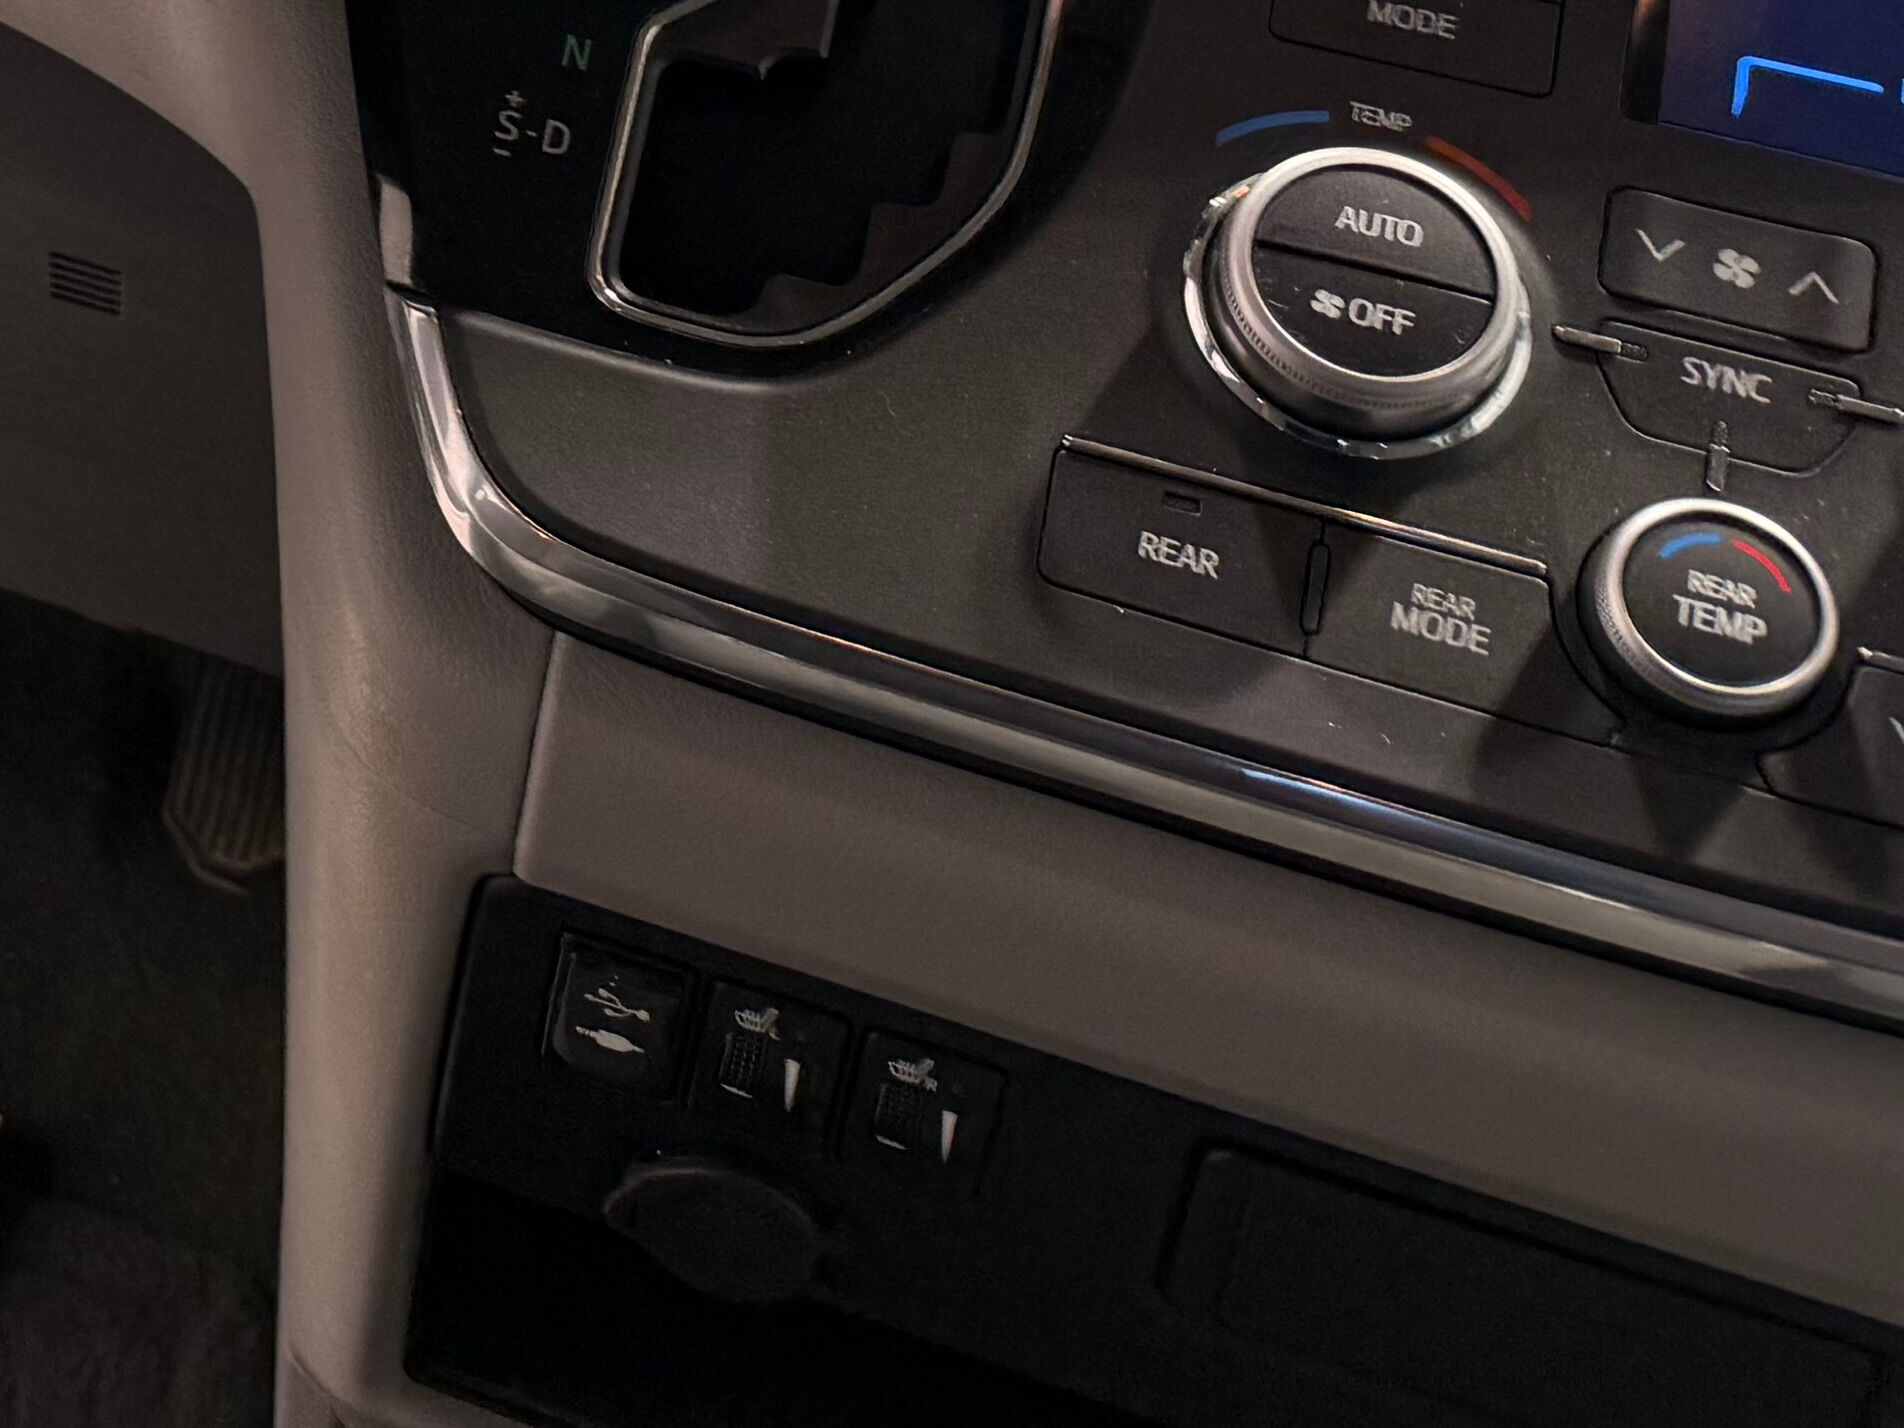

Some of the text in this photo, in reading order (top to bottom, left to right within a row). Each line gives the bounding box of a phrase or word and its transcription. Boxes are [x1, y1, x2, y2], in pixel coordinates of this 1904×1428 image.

[560, 34, 592, 71] N
[1348, 100, 1413, 132] TEMP
[1334, 204, 1425, 249] AUTO
[1347, 297, 1417, 337] OFF
[1679, 355, 1773, 405] SYNC
[1136, 530, 1220, 582] REAR
[1409, 581, 1477, 621] REAR
[1685, 568, 1758, 609] REAR
[1390, 601, 1491, 657] MODE
[1672, 594, 1768, 645] TEMP
